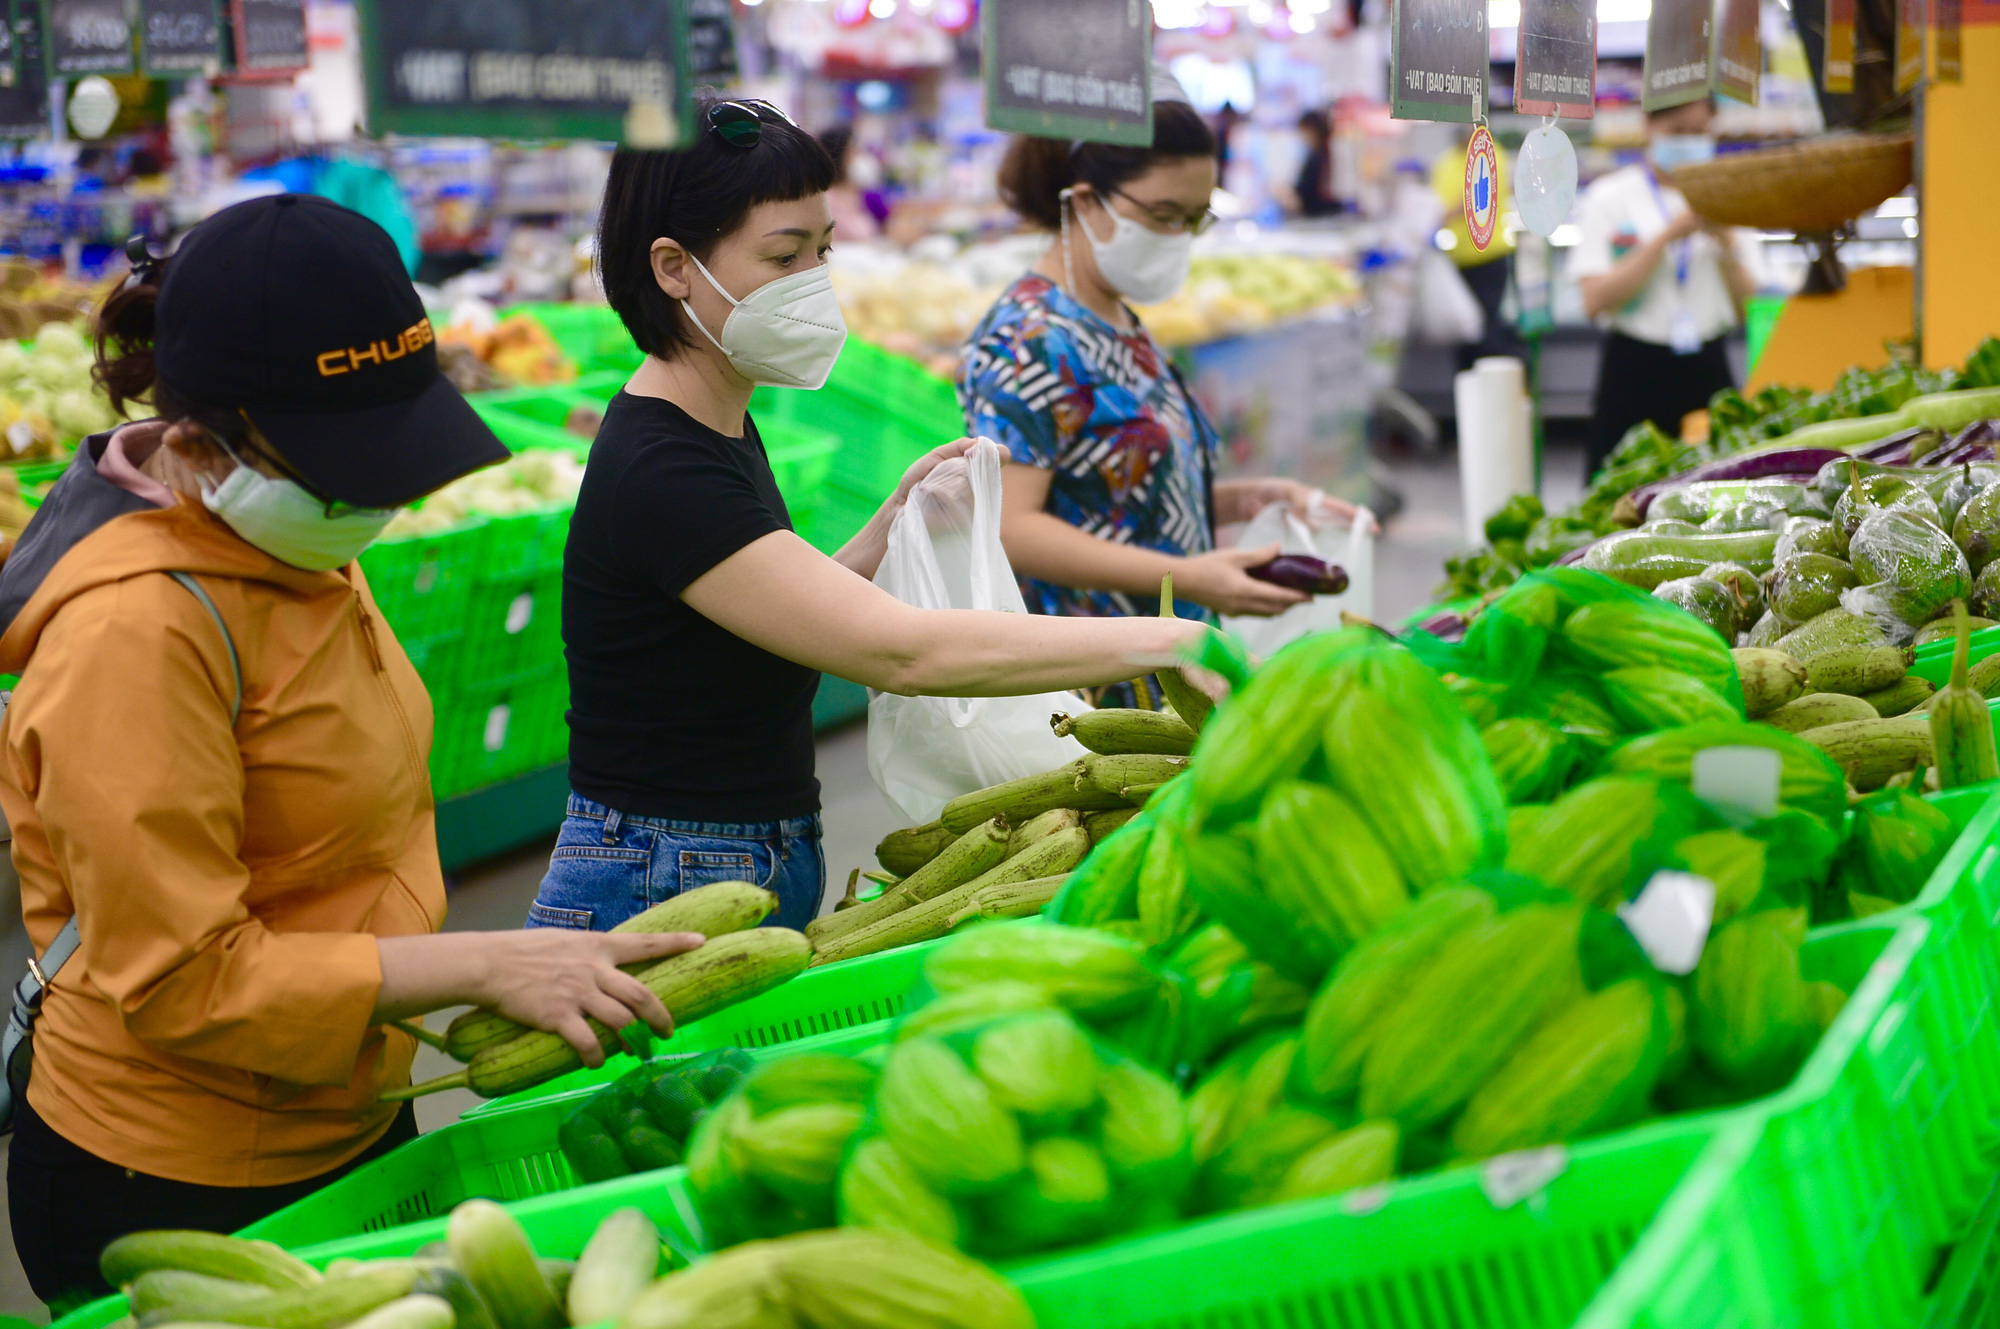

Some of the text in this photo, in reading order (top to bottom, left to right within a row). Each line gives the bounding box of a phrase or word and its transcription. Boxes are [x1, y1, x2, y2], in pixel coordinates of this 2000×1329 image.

[1405, 65, 1483, 96] +VAT (BAO GỒM THUẾ)
[1526, 71, 1541, 90] +VAT
[1541, 73, 1557, 95] (BAO
